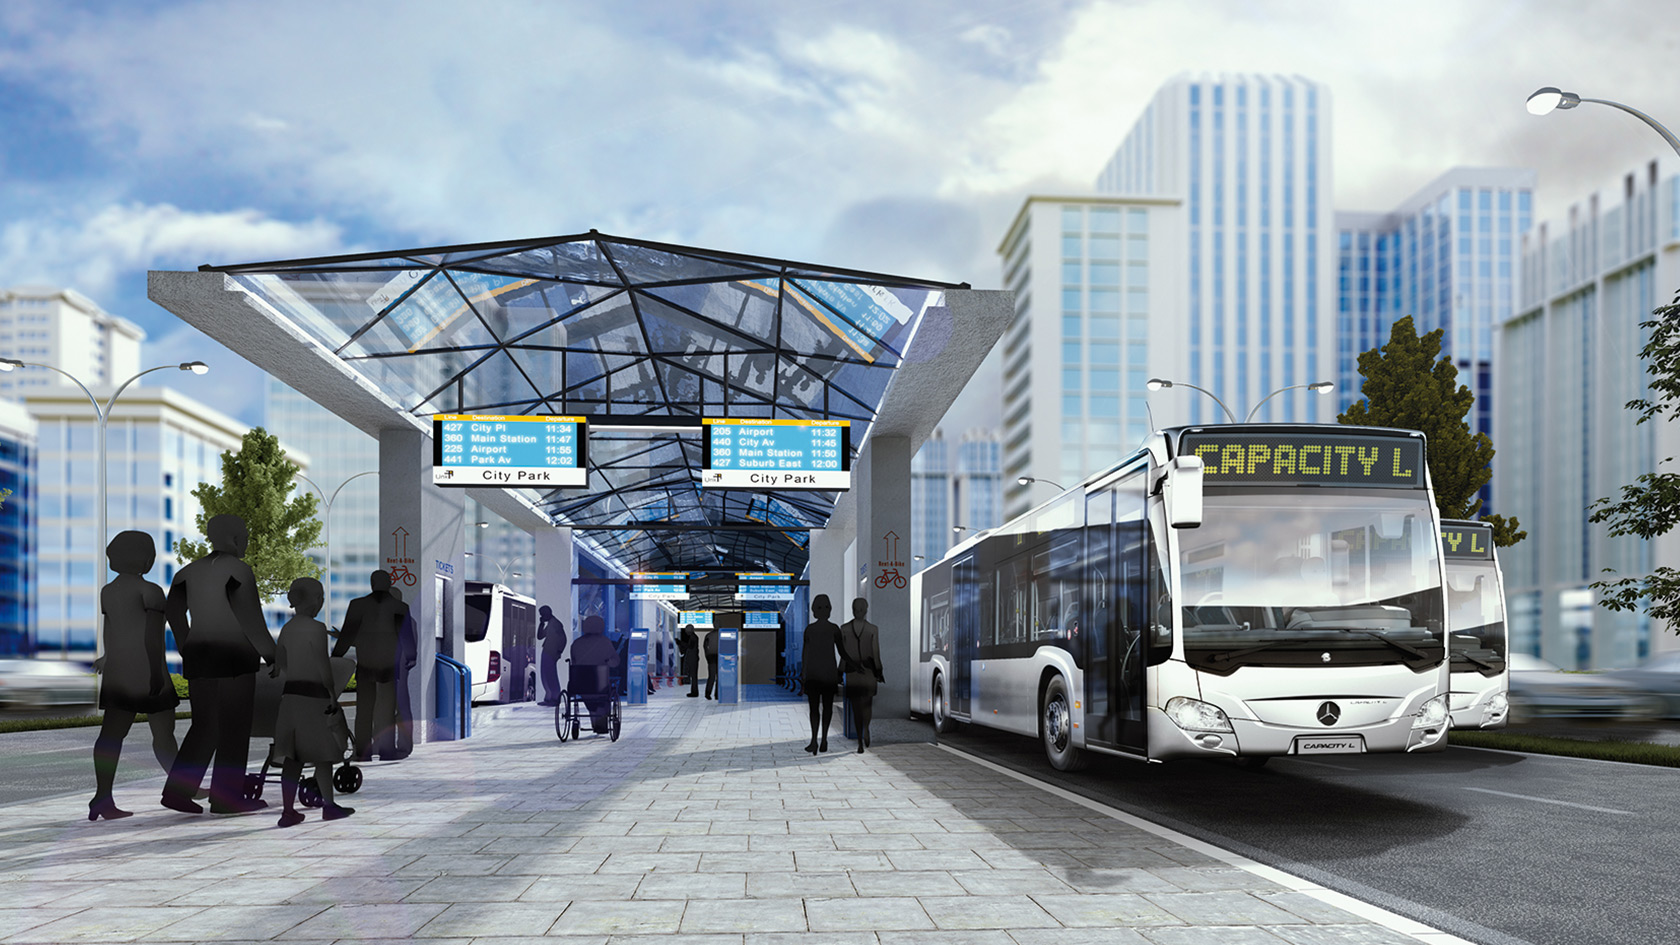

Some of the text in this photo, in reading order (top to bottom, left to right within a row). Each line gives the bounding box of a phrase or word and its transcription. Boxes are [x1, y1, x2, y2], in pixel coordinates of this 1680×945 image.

[471, 424, 492, 433] City
[739, 428, 773, 437] Airport
[500, 435, 537, 443] Station
[739, 438, 759, 447] City
[471, 446, 507, 454] Airport
[1195, 444, 1412, 477] CAPACITY L
[482, 470, 550, 482] City Park
[750, 474, 816, 485] City Park
[1471, 533, 1484, 552] L
